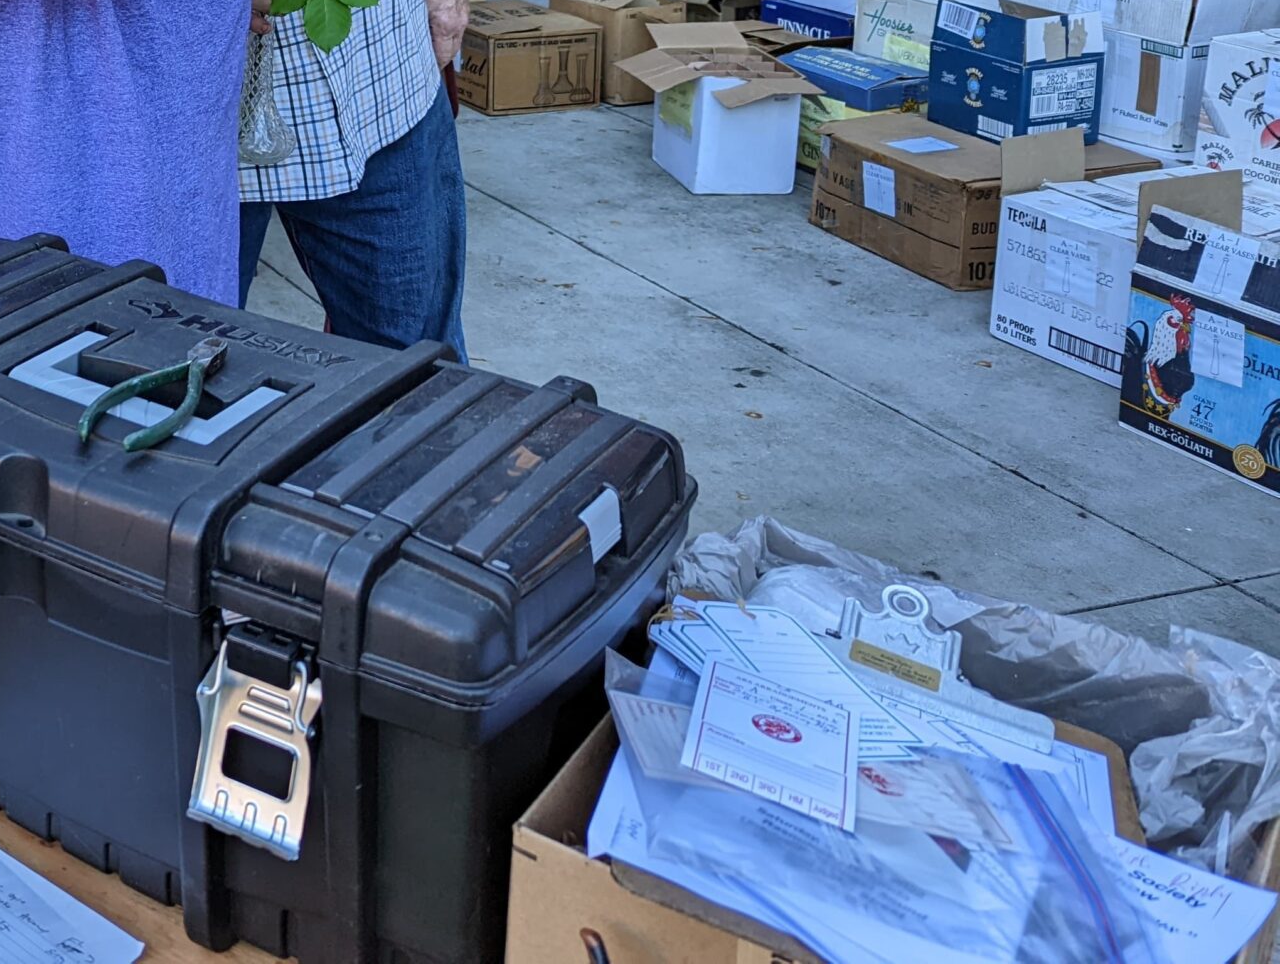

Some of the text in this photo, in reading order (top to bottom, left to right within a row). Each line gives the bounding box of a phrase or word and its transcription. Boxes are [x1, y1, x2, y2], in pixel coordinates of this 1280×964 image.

[863, 1, 914, 42] Hoosier
[1201, 141, 1235, 161] MALIBU
[833, 172, 855, 191] VASE
[972, 223, 997, 235] BUD
[1007, 207, 1047, 234] TEQUILA
[1049, 246, 1091, 262] CLEAR VASES
[1205, 240, 1256, 261] CLEAR VASES
[995, 323, 1037, 347] 9.0 LITERS
[996, 314, 1035, 336] 80 PROOF
[1195, 321, 1243, 341] CLEAR VASES
[177, 314, 356, 369] HUSKY
[1193, 394, 1217, 408] GIANT
[1190, 414, 1214, 428] POUND
[1192, 403, 1215, 421] 47
[1148, 422, 1214, 459] REX-GOLIATH
[704, 759, 722, 773] 1ST
[730, 772, 749, 784] 2ND
[758, 782, 777, 795] 3RD
[788, 792, 804, 806] HM
[1127, 869, 1208, 909] Society
